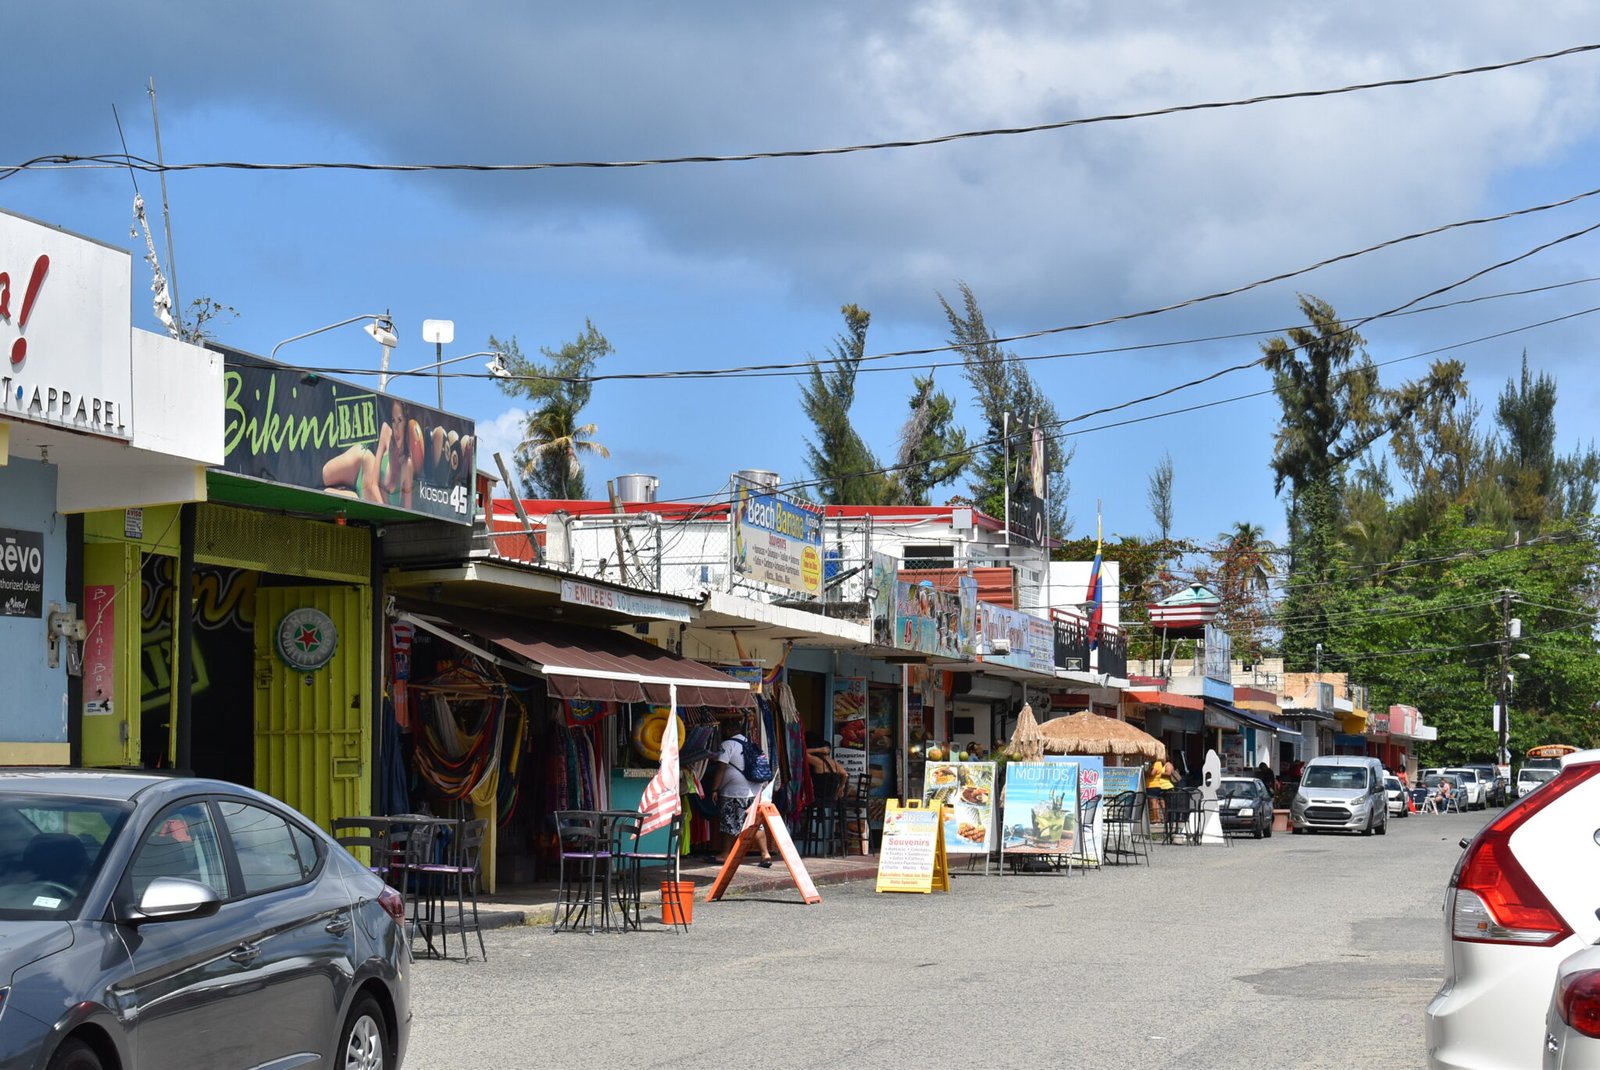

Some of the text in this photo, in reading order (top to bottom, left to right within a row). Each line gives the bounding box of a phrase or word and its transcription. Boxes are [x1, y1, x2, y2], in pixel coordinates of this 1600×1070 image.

[27, 385, 126, 429] APPAREL
[224, 371, 341, 458] Bikini
[337, 401, 378, 441] BAR
[420, 481, 468, 514] kiosco 45
[748, 496, 775, 531] Beach
[24, 580, 41, 592] dealer
[574, 584, 613, 608] EMILEE'S
[1015, 767, 1070, 781] MOJITOS
[888, 838, 930, 846] Souvenirs
